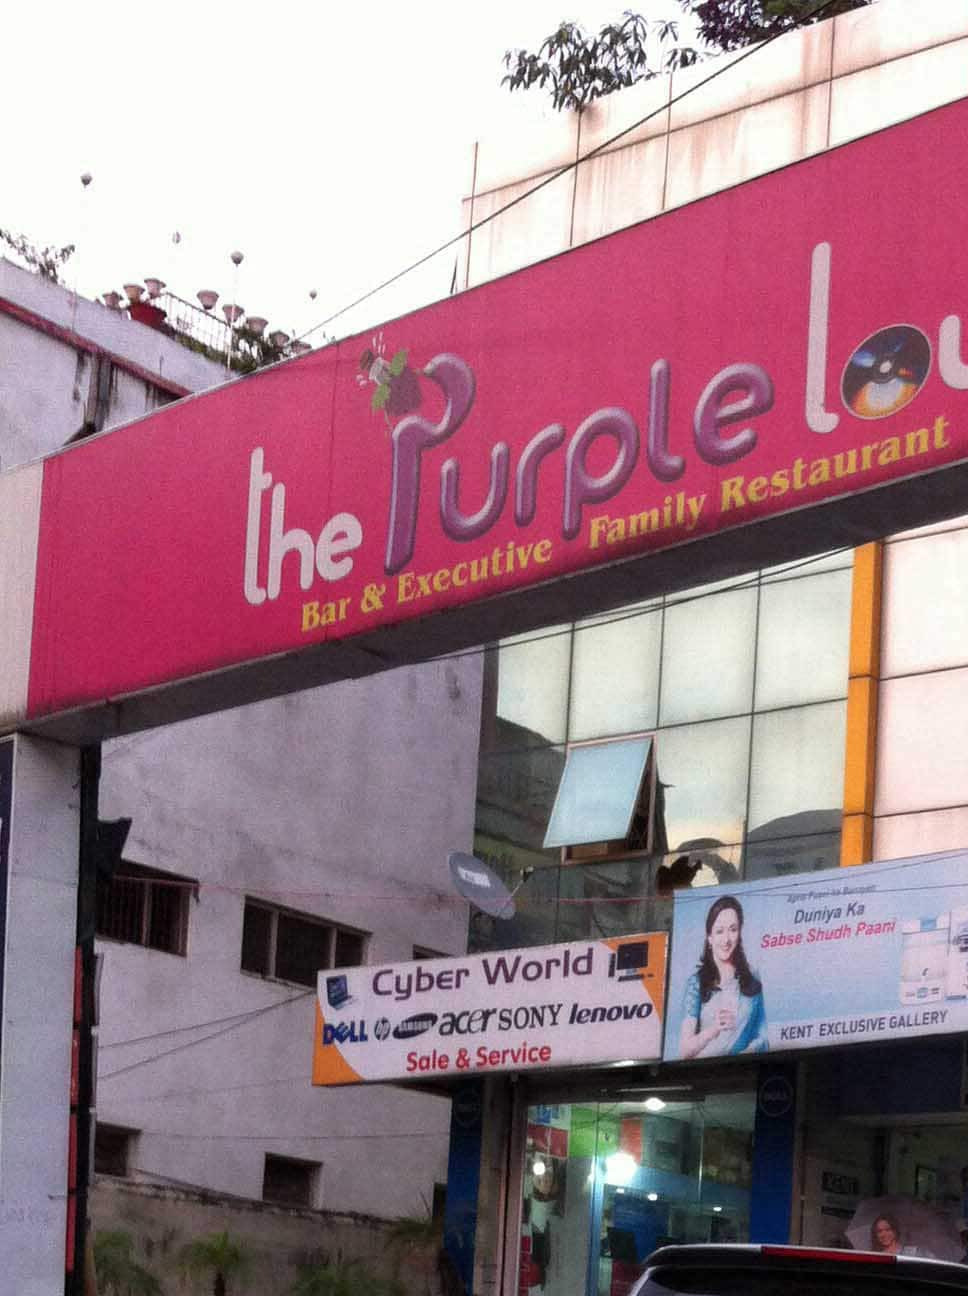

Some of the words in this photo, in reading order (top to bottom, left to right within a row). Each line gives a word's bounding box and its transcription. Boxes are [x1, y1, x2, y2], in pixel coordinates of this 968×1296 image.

[243, 446, 363, 605] the
[384, 352, 775, 576] Purple
[302, 599, 350, 632] Bar
[360, 582, 387, 613] &
[397, 538, 553, 604] Executive
[589, 490, 706, 549] Family
[720, 416, 949, 512] Restaurant
[794, 906, 842, 924] Duniya
[846, 901, 865, 917] Ka
[761, 933, 803, 949] Sabse
[806, 924, 852, 943] Shudh
[372, 967, 470, 1001] Cyber
[482, 947, 594, 985] World
[322, 1019, 368, 1046] DELL
[439, 1007, 498, 1036] acer
[498, 1003, 562, 1031] SONY
[568, 1001, 653, 1025] lenovo
[780, 1025, 813, 1041] KENT
[819, 1017, 886, 1037] EXCLUSIVE
[888, 1010, 949, 1030] GALLERY
[406, 1049, 449, 1073] Sale
[456, 1047, 470, 1069] &
[477, 1040, 552, 1067] Service
